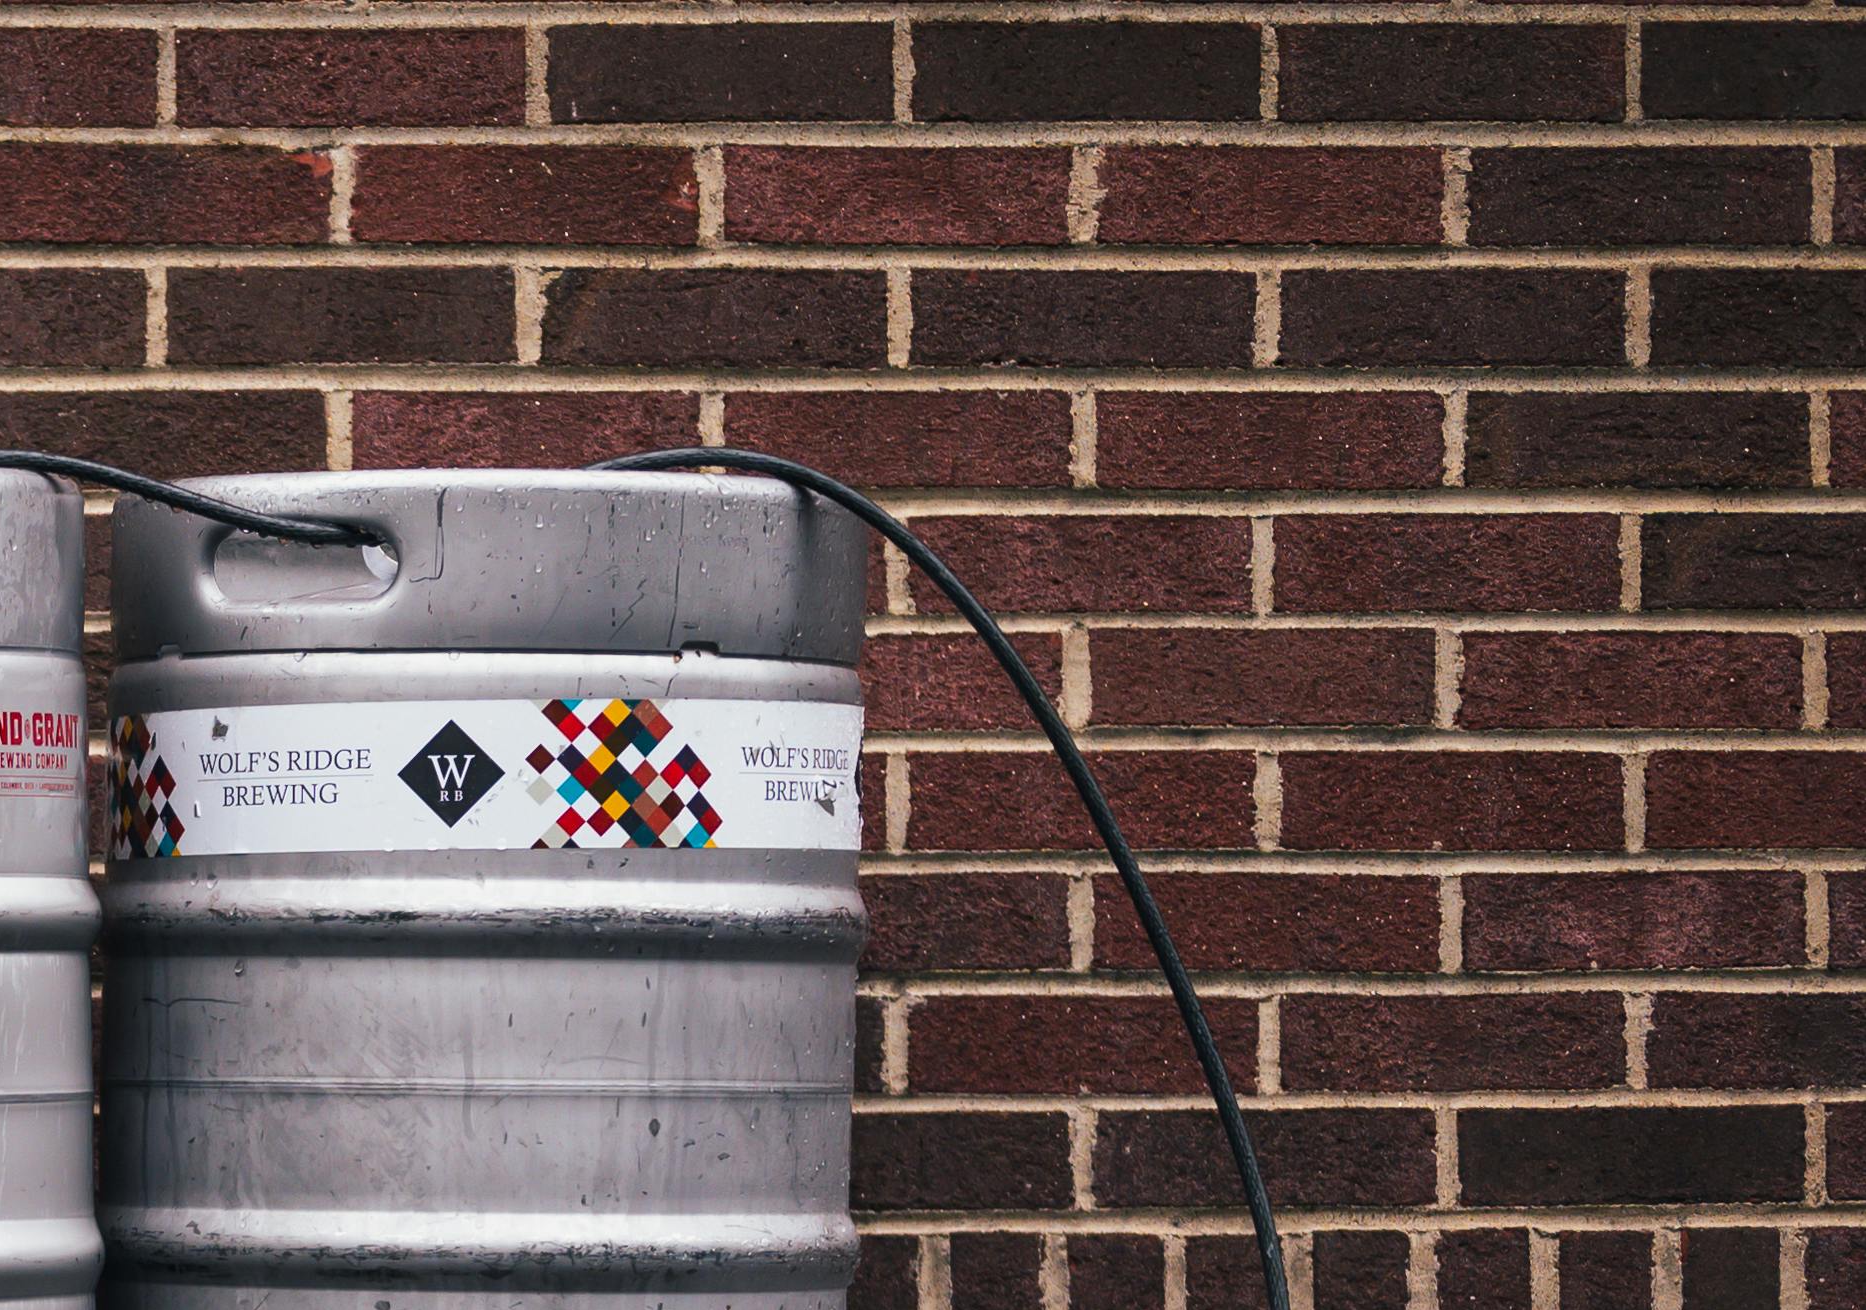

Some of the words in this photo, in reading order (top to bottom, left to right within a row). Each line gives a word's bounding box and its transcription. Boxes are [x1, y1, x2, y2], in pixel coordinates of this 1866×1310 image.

[32, 713, 80, 749] GRANT
[35, 754, 68, 770] COMPANY
[199, 750, 280, 775] WOLF'S
[286, 748, 372, 771] RIDGE
[813, 748, 849, 770] RIDGE
[427, 754, 476, 790] W
[222, 782, 340, 807] BREWING
[440, 790, 450, 802] R
[454, 790, 463, 802] B
